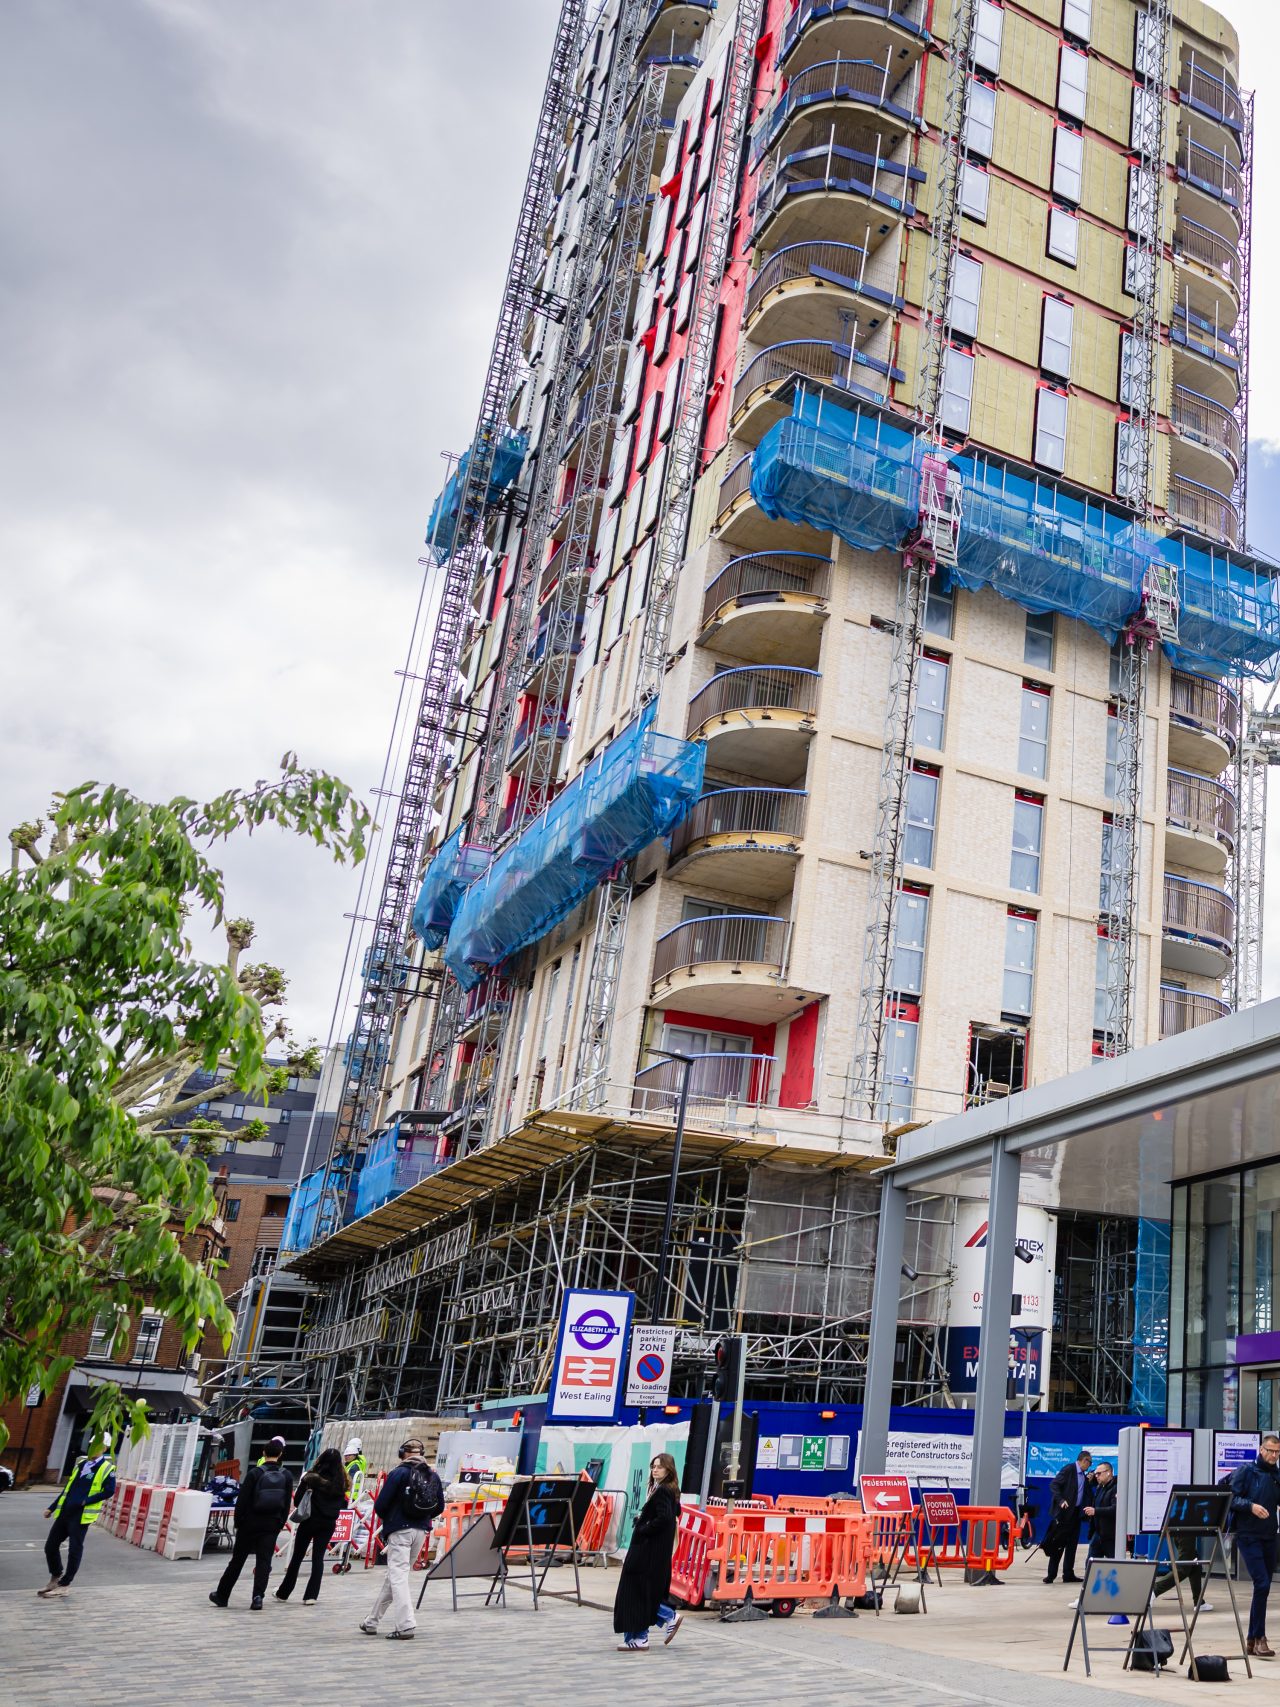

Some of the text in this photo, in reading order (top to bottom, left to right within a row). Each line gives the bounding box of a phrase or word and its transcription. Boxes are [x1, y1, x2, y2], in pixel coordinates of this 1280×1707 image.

[571, 1325, 603, 1333] ELIZABETH
[639, 1344, 666, 1352] ZONE
[641, 1383, 668, 1391] loading
[560, 1391, 612, 1402] West Ealing
[891, 1440, 931, 1450] registered
[932, 1441, 949, 1450] with
[950, 1442, 962, 1451] the
[911, 1450, 960, 1460] Constructors
[863, 1479, 907, 1487] PEDESTRIANS
[927, 1501, 954, 1509] FOOTWAY
